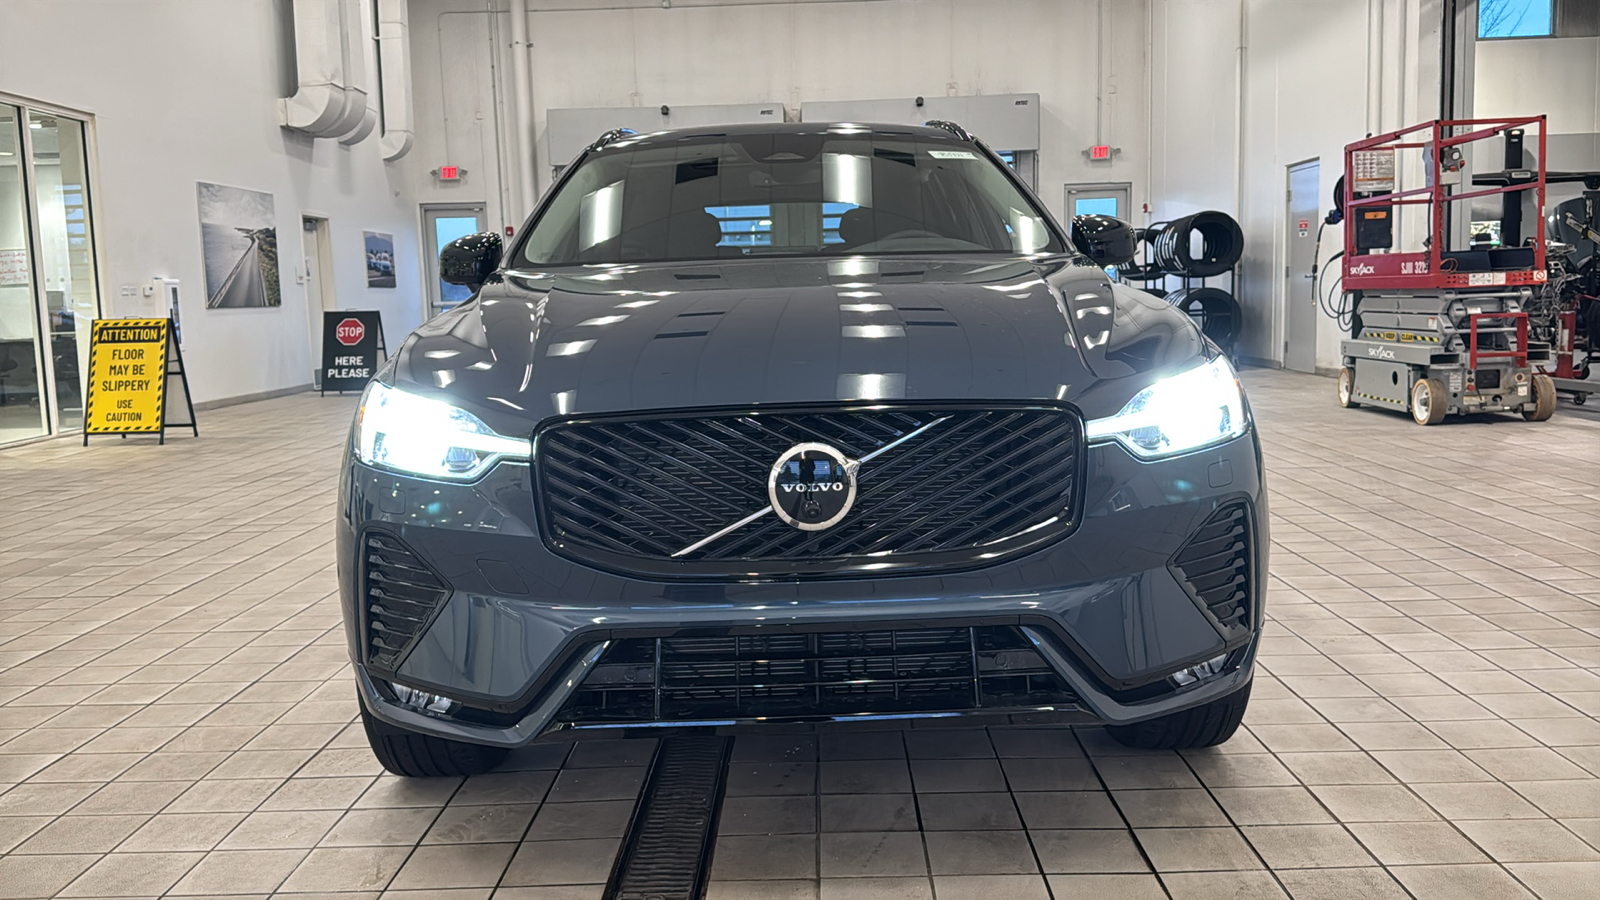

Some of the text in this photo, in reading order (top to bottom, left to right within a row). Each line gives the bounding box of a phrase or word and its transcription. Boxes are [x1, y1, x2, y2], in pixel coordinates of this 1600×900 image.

[1092, 146, 1108, 158] EXIT
[442, 166, 457, 179] EXIT
[1350, 262, 1375, 276] SKYJACK
[101, 328, 158, 341] ATTENTION
[338, 326, 363, 338] STOP
[112, 349, 145, 360] FLOOR
[1368, 345, 1395, 359] SKYJACK
[335, 356, 364, 366] HERE
[109, 364, 145, 376] MAY BE
[327, 368, 370, 379] PLEASE
[102, 380, 150, 392] SLIPPERY
[116, 399, 133, 409] USE
[106, 412, 142, 422] CAUTION
[781, 482, 844, 493] VOLVO
